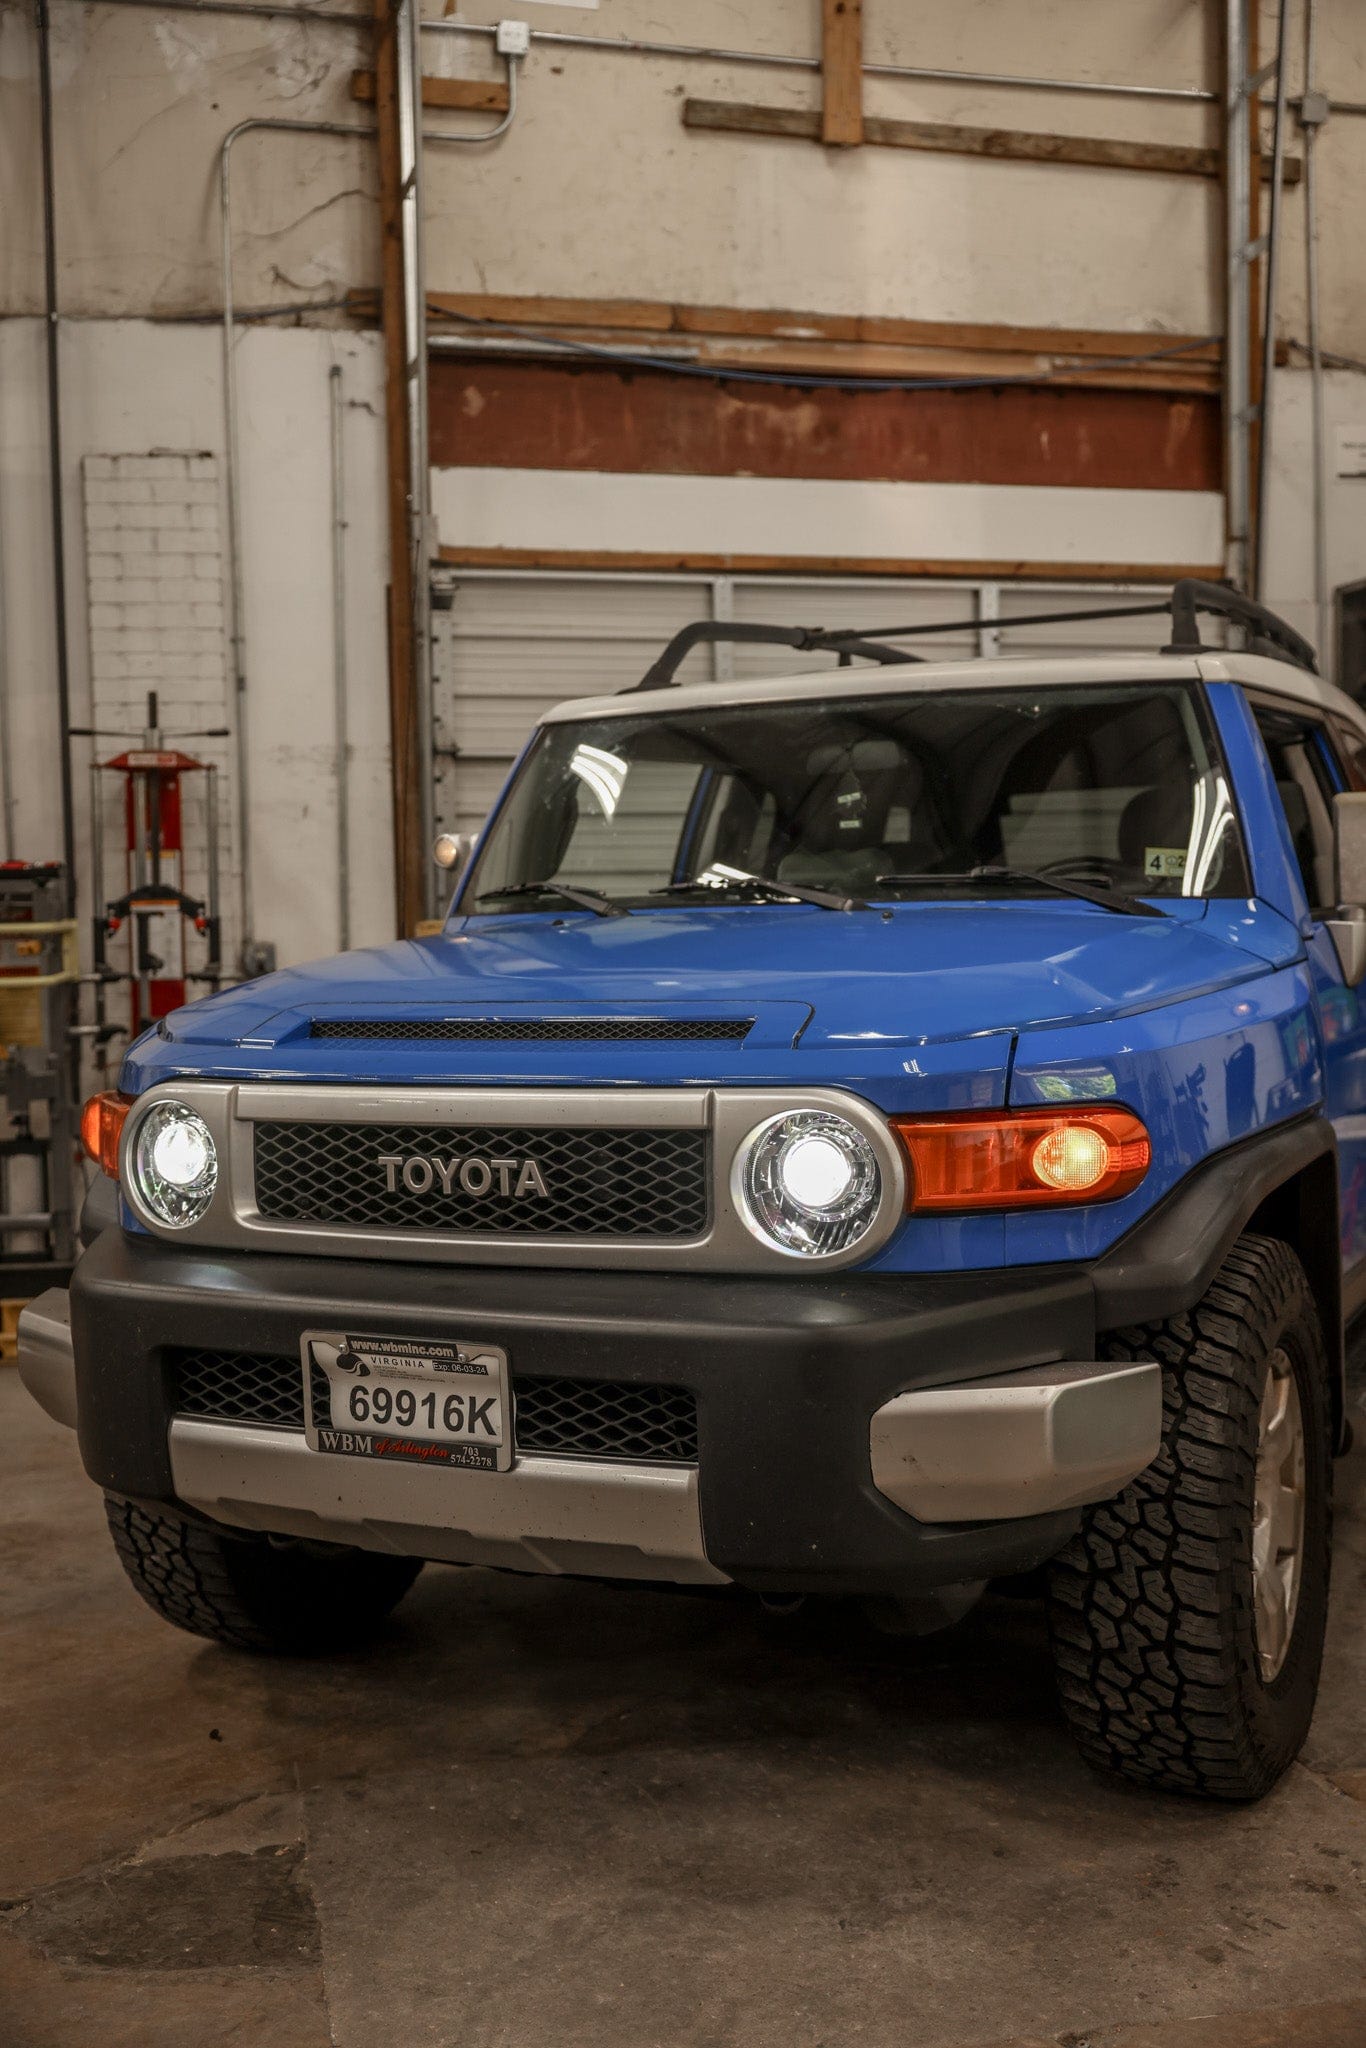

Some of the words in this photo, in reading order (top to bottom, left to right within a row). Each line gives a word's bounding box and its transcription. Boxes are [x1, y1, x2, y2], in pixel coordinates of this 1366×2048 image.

[1150, 854, 1162, 871] 4
[378, 1156, 549, 1197] TOYOTA
[350, 1340, 454, 1358] www.wbminc.com
[370, 1356, 425, 1368] VIRGINIA
[433, 1363, 450, 1372] Exp:
[350, 1384, 498, 1436] 69916K
[320, 1431, 373, 1455] WBM
[375, 1438, 391, 1455] of
[462, 1446, 479, 1457] 703
[450, 1454, 493, 1467] 574-2278
